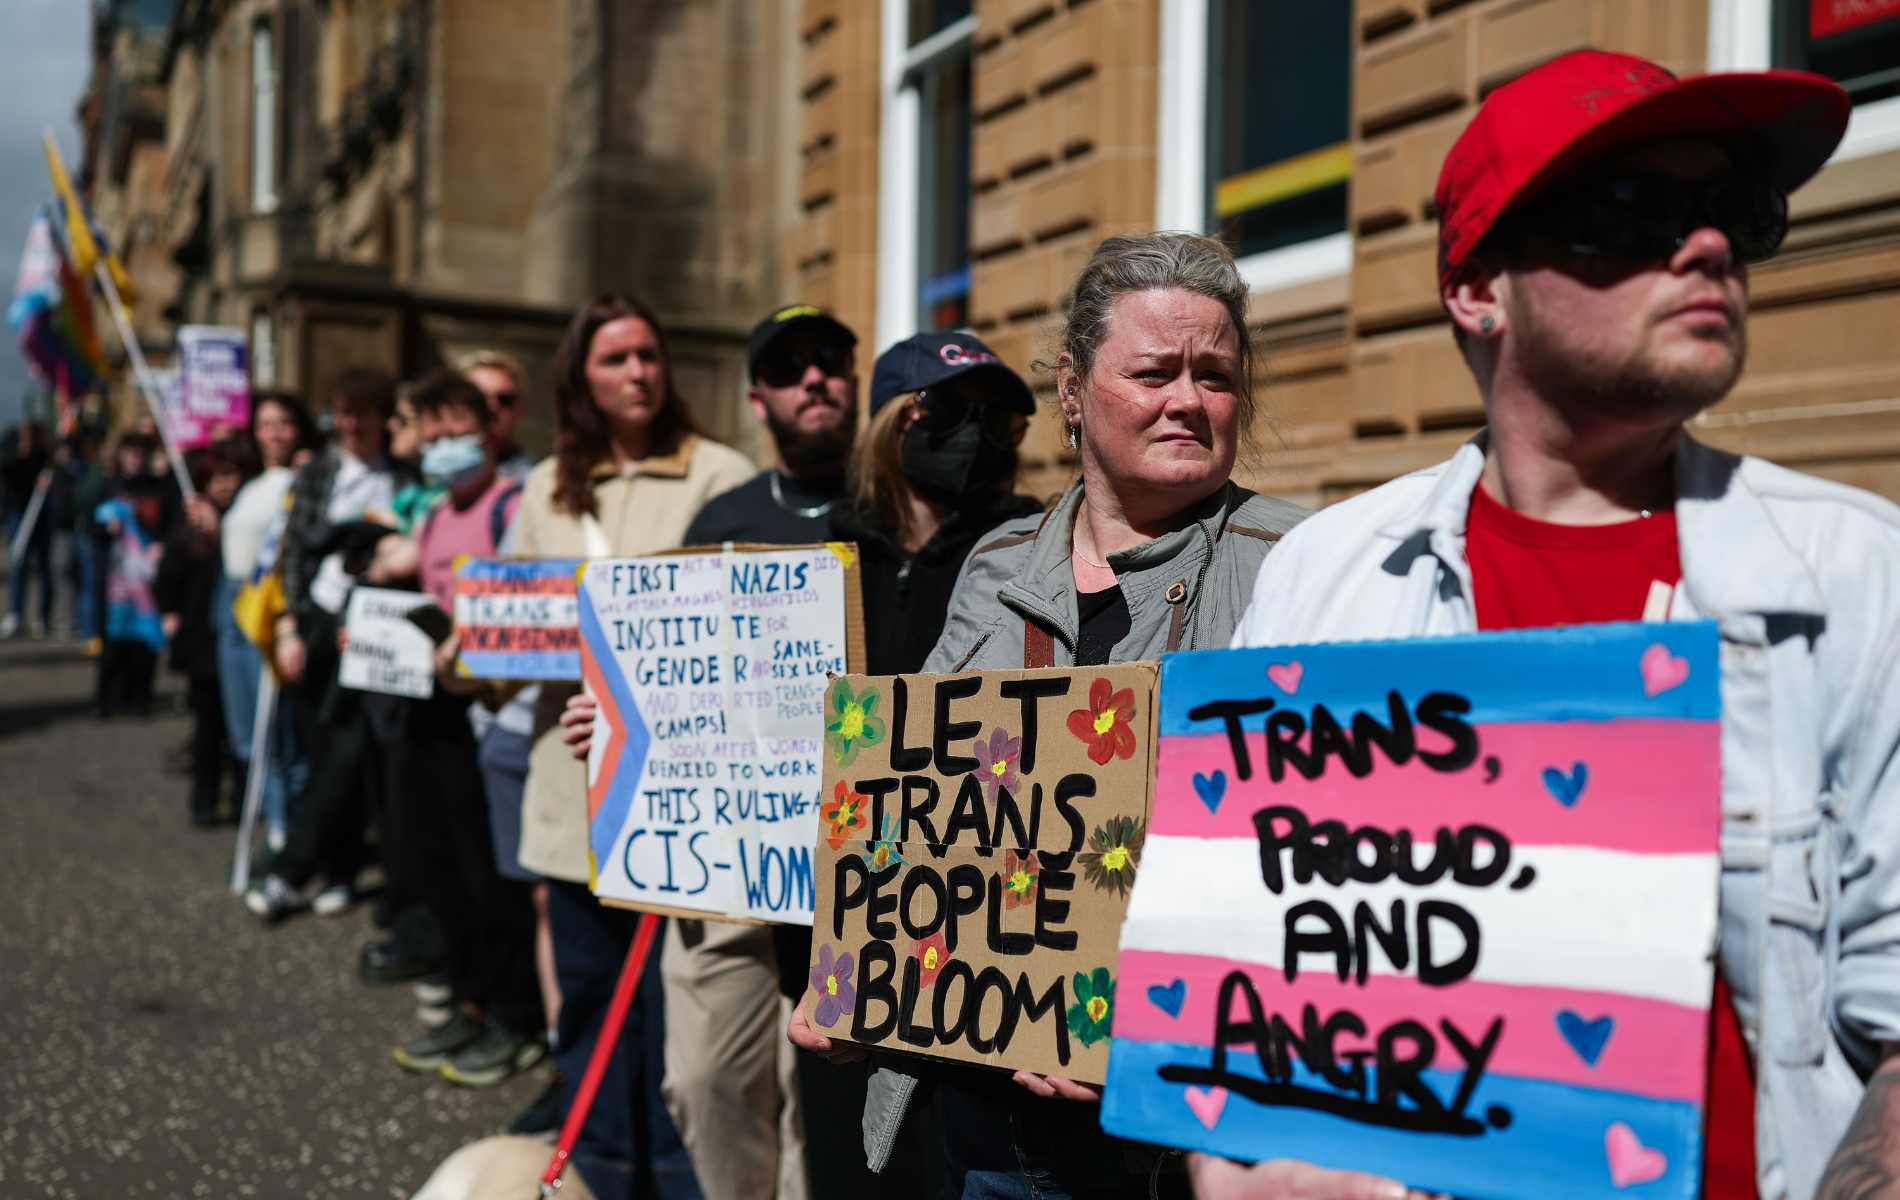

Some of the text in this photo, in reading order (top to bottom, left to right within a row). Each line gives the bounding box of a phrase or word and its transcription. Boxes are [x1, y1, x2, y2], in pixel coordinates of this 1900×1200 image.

[612, 563, 680, 597] FIRST
[730, 561, 809, 595] NAZIS
[815, 556, 839, 572] DID
[766, 617, 789, 635] FOR
[804, 656, 842, 677] LOVE
[644, 690, 679, 718] AND
[776, 701, 824, 720] PEOPLE
[654, 710, 727, 741] CAMPS!
[889, 675, 1073, 776] LET
[1188, 689, 1502, 784] TRANS,
[669, 737, 818, 759] SOON AFTER WOMEN
[648, 759, 817, 780] DENIED TO WORK
[643, 787, 701, 824] THIS
[714, 787, 810, 826] RULING
[854, 772, 1097, 870] TRANS
[1252, 805, 1538, 896] PROUD,
[833, 853, 1079, 956] PEOPLE
[1283, 898, 1482, 987] AND
[850, 939, 1072, 1067] BLOOM
[1211, 970, 1514, 1132] ANGRY.
